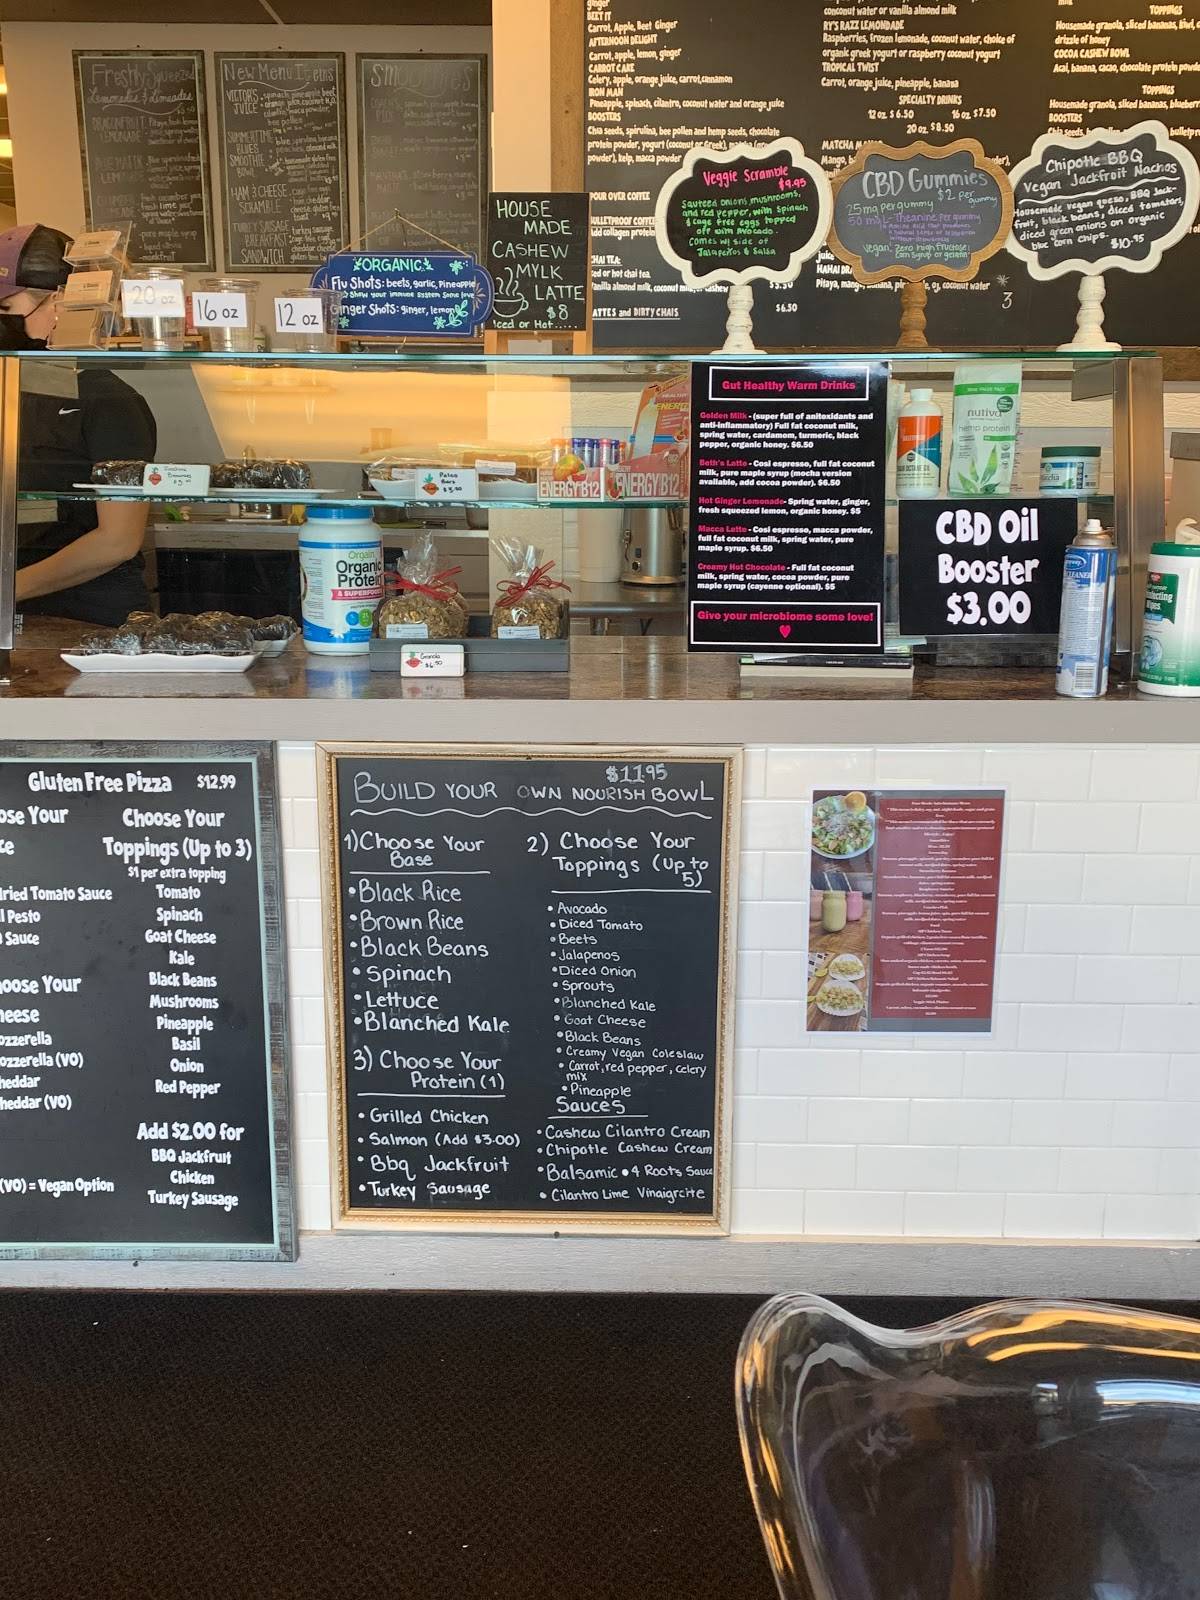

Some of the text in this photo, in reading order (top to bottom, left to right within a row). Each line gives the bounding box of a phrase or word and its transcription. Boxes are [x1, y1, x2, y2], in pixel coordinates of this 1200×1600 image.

[1150, 5, 1182, 15] TOPPINGS
[589, 34, 657, 47] AFTERNOON DELIGHT
[615, 51, 635, 61] apple,
[637, 49, 658, 59] lemon,
[660, 46, 681, 59] ginger
[1054, 48, 1130, 58] COCOA CASHEW BOWL
[224, 63, 292, 81] New Menu
[822, 62, 879, 72] TROPICAL TWIST
[933, 78, 959, 88] banana
[899, 95, 962, 105] SPECIALTY DRINKS
[973, 108, 996, 118] $7.50
[931, 122, 954, 132] $8.50
[1046, 149, 1143, 175] Chipotle BBQ
[703, 165, 788, 188] Veggie Scramble
[862, 168, 988, 199] CBD Gummies
[1023, 163, 1177, 197] Vegan Jackfruit Nachos
[778, 178, 807, 191] $9.95
[590, 192, 650, 200] POUR OVER COFFEE
[938, 189, 974, 201] $2 per
[496, 200, 552, 218] HOUSE
[880, 203, 895, 213] per
[896, 200, 933, 213] gummy
[524, 220, 572, 235] MADE
[492, 241, 568, 258] CASHEW
[361, 258, 422, 272] ORGANIC
[516, 264, 563, 280] MYLK
[332, 276, 438, 290] Flu Shots: beets, garlic,
[132, 286, 175, 305] 20 oz
[535, 285, 585, 300] LATTE
[197, 299, 238, 320] 16 oz
[278, 304, 318, 327] 12 oz
[368, 302, 429, 316] Shots: ginger,
[633, 308, 679, 317] DIRTY CHAIS
[776, 304, 797, 312] $6.50
[493, 319, 514, 328] Iced
[722, 380, 855, 392] Gut Healthy Warm Drinks
[699, 431, 725, 439] spring
[726, 431, 751, 439] water,
[699, 441, 730, 449] pepper,
[732, 441, 761, 449] organic
[763, 441, 789, 449] honey.
[541, 481, 600, 497] ENERGY B12
[936, 508, 1039, 546] CBD Oil
[938, 554, 1040, 586] Booster
[946, 591, 1031, 625] $3.00
[697, 611, 874, 621] Give your microbiome some love!
[28, 771, 236, 792] Gluten Free Pizza $12.99
[354, 772, 713, 802] BUILD YOUR OWN NOURISH BOWL
[123, 808, 225, 828] Choose Your
[528, 831, 695, 855] 2) Choose Your
[103, 837, 252, 866] Toppings (Up to 3)
[390, 853, 433, 867] Base
[552, 857, 640, 878] Toppings
[31, 886, 112, 901] Tomato Sauce
[156, 884, 200, 899] Tomato
[359, 879, 461, 902] Black Rice
[157, 906, 203, 926] Spinach
[558, 903, 607, 915] Avocado
[360, 909, 463, 931] Brown Rice
[560, 919, 642, 931] Diced Tomato
[145, 929, 216, 944] Goat Cheese
[169, 951, 194, 965] Kale
[149, 972, 217, 988] Black Beans
[150, 995, 219, 1009] Mushrooms
[366, 992, 439, 1010] Lettuce
[157, 1014, 213, 1035] Pineapple
[172, 1037, 200, 1051] Basil
[170, 1059, 204, 1073] Onion
[411, 1072, 475, 1089] Protein
[155, 1080, 221, 1099] Red Pepper
[556, 1096, 625, 1114] Sauces
[370, 1108, 488, 1125] Grilled Chicken
[137, 1122, 244, 1141] Add $2.00 for
[152, 1149, 231, 1164] BBQ Jackfruit
[170, 1170, 214, 1184] Chicken
[38, 1177, 114, 1198] Vegan Option
[551, 1186, 629, 1201] Cilantro Lime
[148, 1190, 238, 1212] Turkey Sausage
